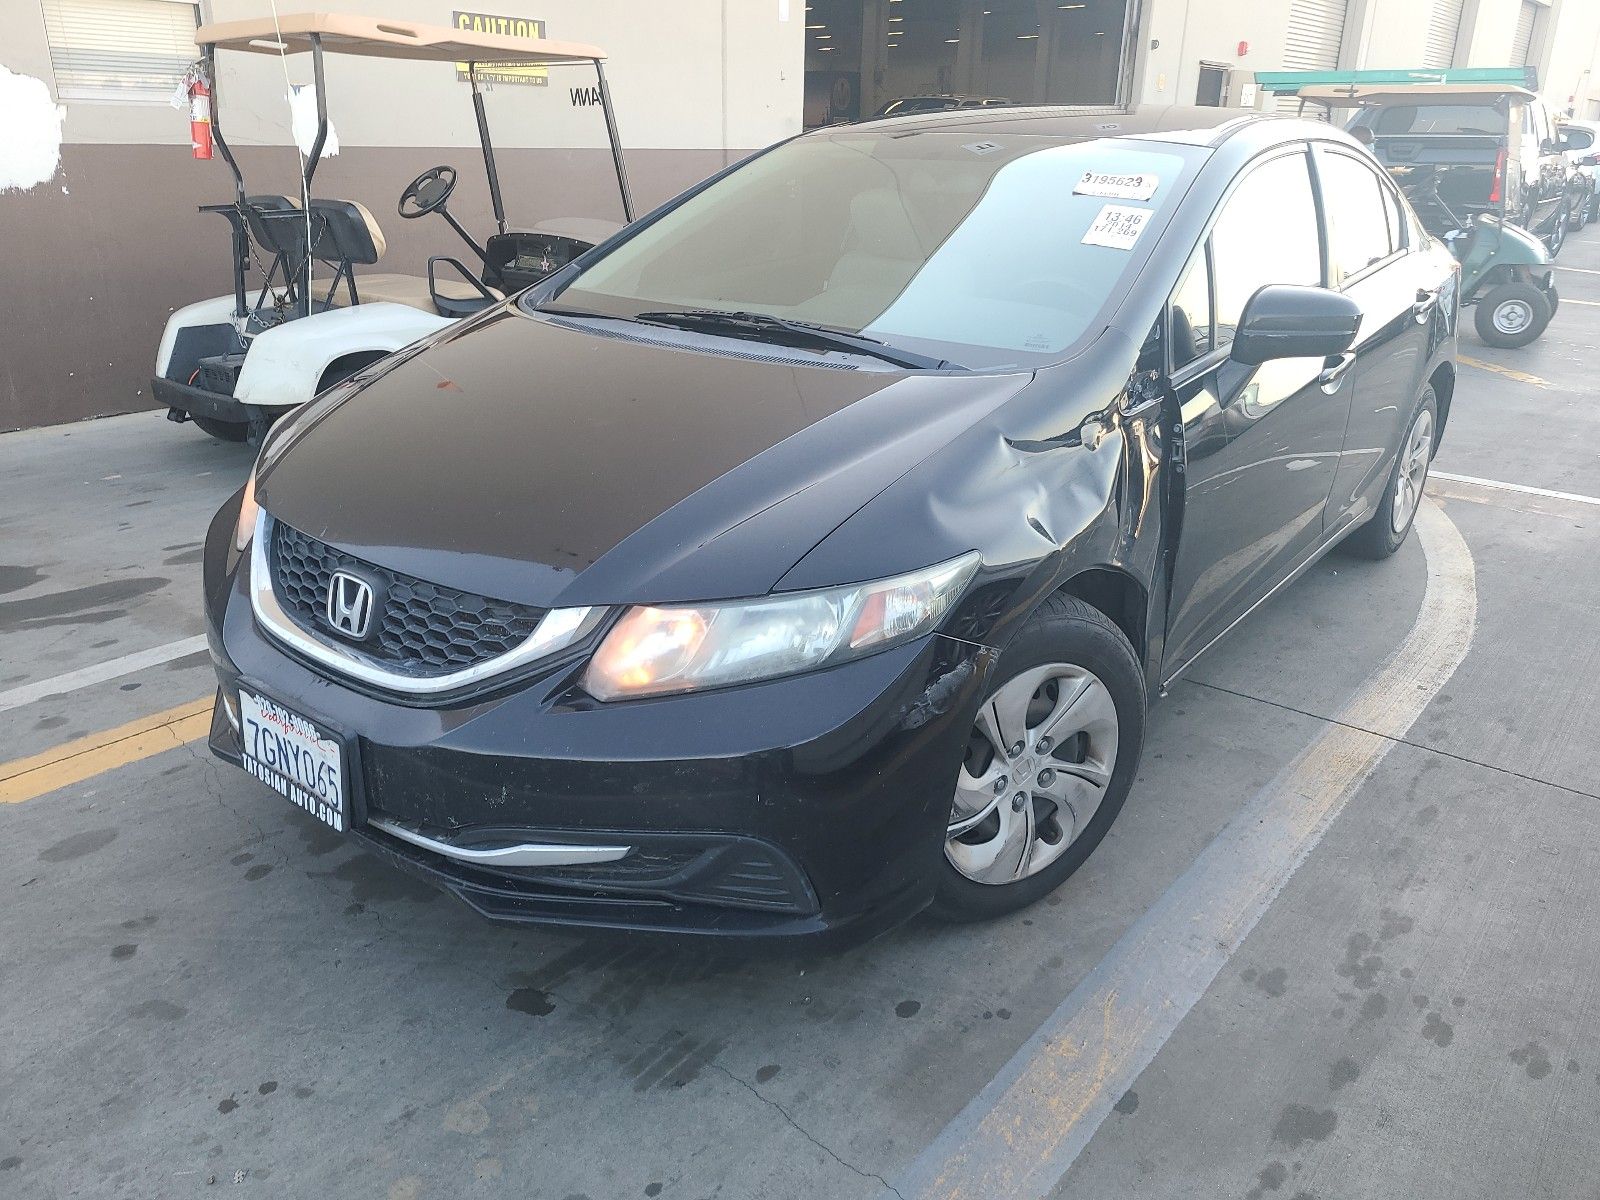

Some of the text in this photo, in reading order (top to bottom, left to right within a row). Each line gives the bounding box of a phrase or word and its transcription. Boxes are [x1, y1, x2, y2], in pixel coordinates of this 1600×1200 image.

[458, 14, 539, 39] CAUTION
[1081, 172, 1143, 188] 3195623
[242, 752, 288, 797] TATOSIAN
[247, 718, 339, 809] 7GNY065
